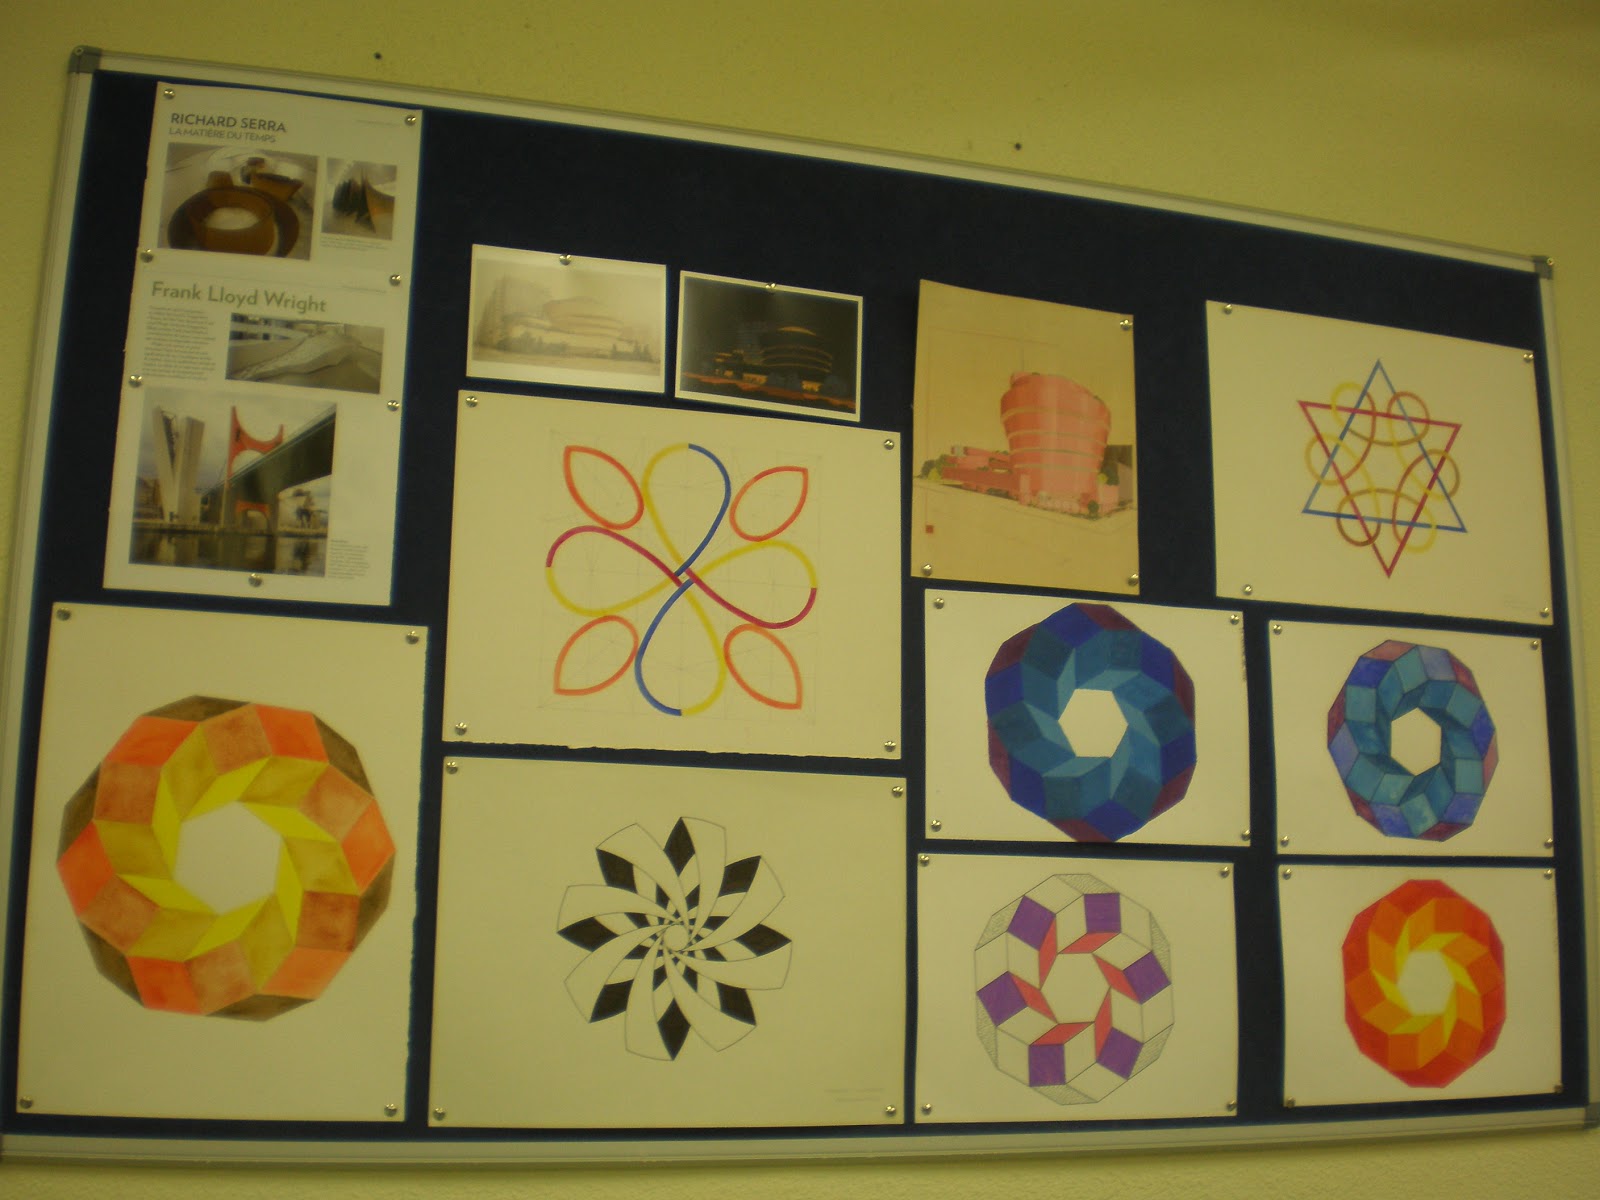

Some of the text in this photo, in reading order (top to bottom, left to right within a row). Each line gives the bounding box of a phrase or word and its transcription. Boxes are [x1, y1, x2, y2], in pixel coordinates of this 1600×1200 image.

[171, 113, 287, 133] RICHARD SERRA
[169, 127, 181, 135] LA
[227, 131, 241, 140] DU
[245, 132, 276, 143] TEMPS
[151, 281, 327, 314] Frank Lloyd Wright
